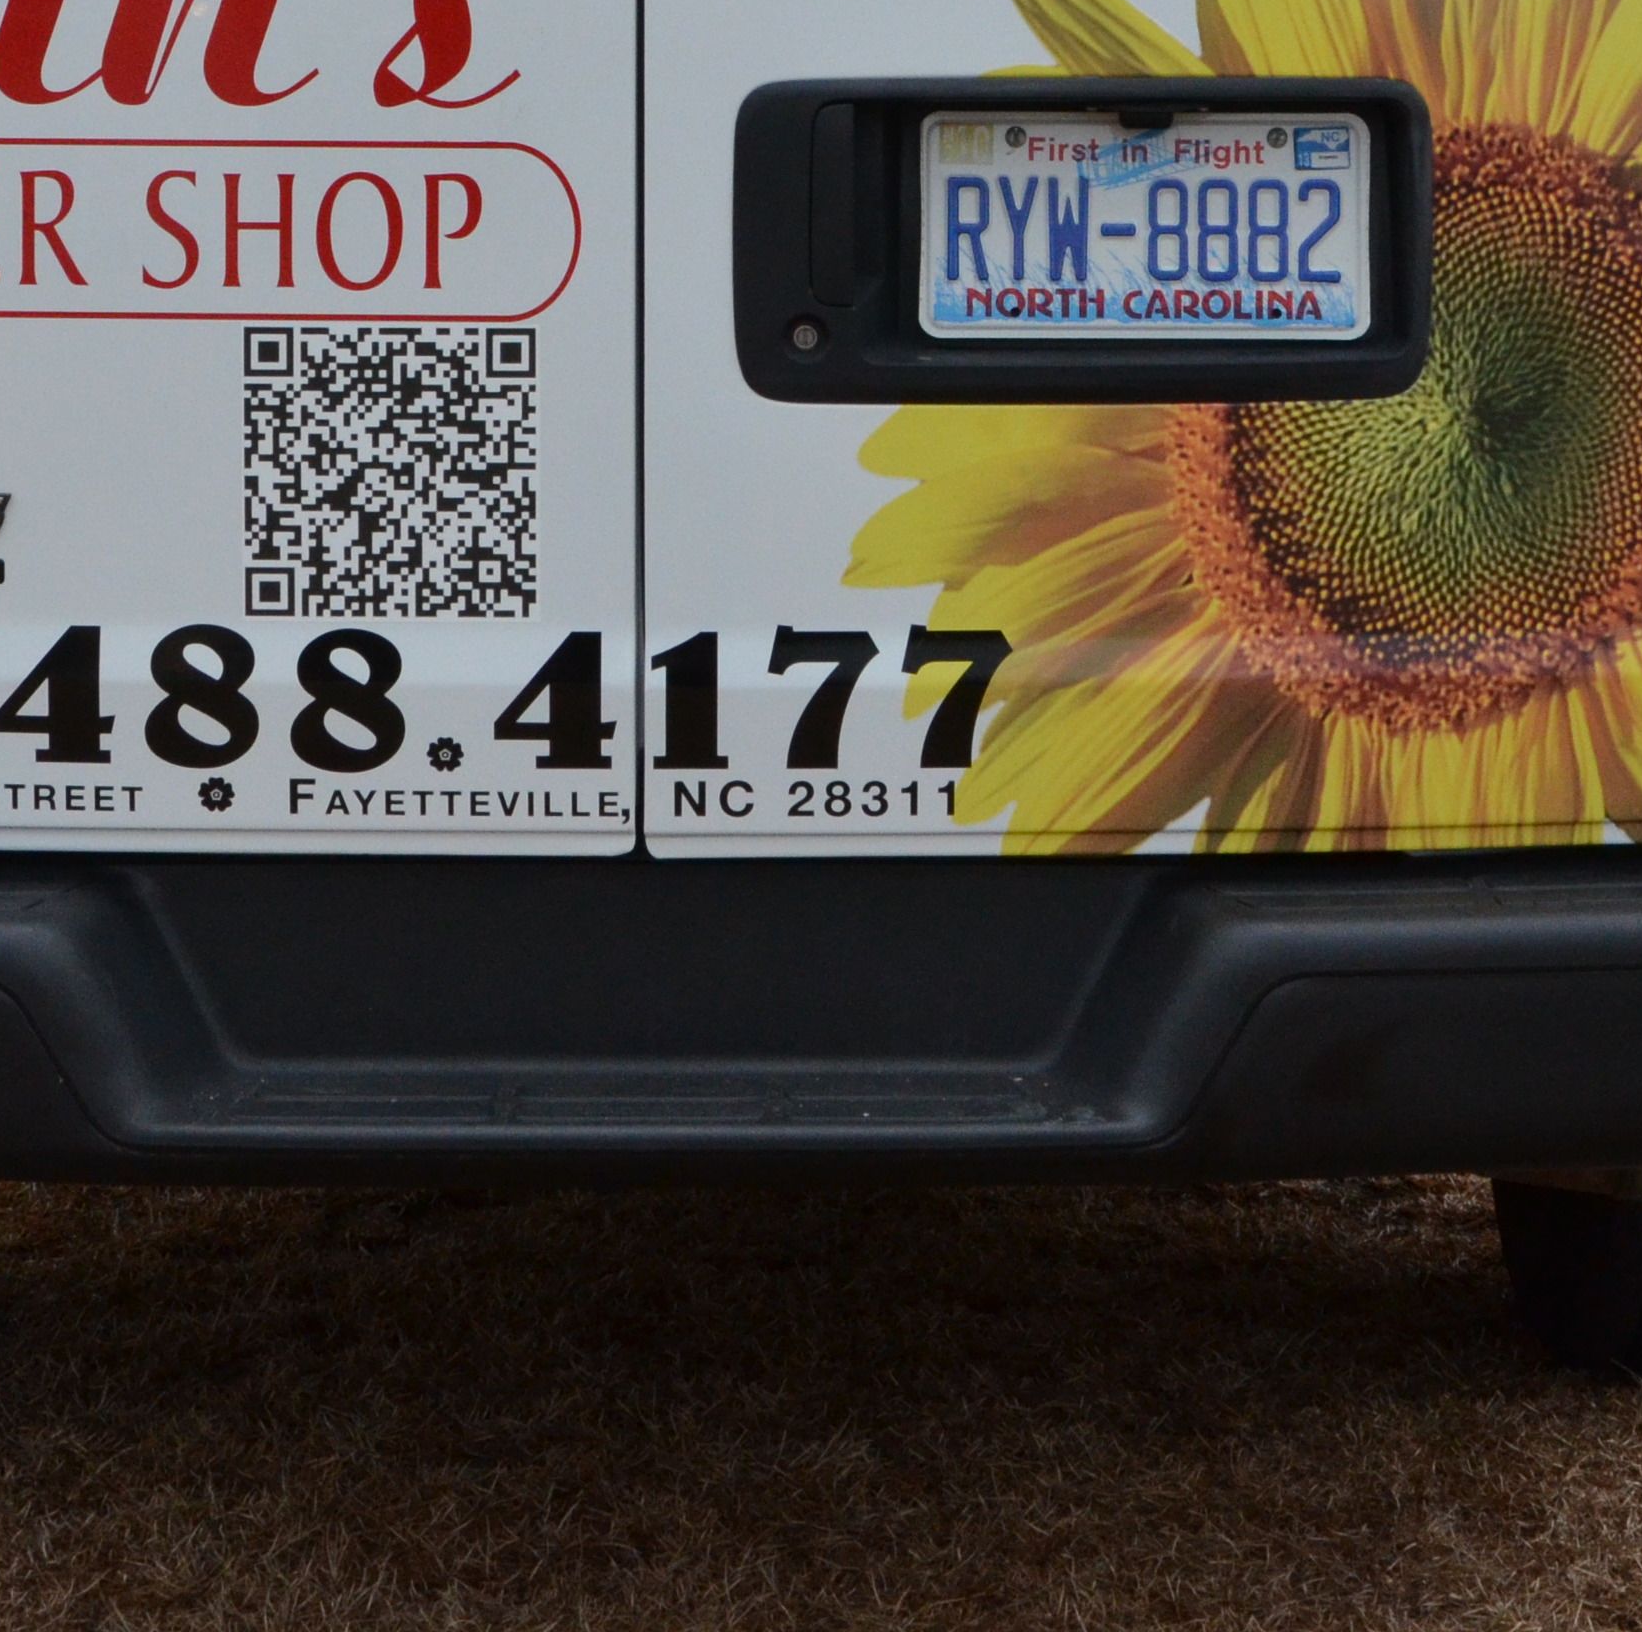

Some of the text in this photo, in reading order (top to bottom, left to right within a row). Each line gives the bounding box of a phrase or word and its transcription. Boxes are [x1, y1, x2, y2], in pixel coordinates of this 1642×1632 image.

[1028, 136, 1265, 169] First in Flight
[142, 170, 483, 292] SHOP
[946, 176, 1342, 284] RYW-8882
[966, 287, 1323, 321] NORTH CAROLINA
[288, 779, 631, 825] FAYETTEVILLE,
[674, 780, 755, 818] NC
[787, 780, 955, 818] 28311
